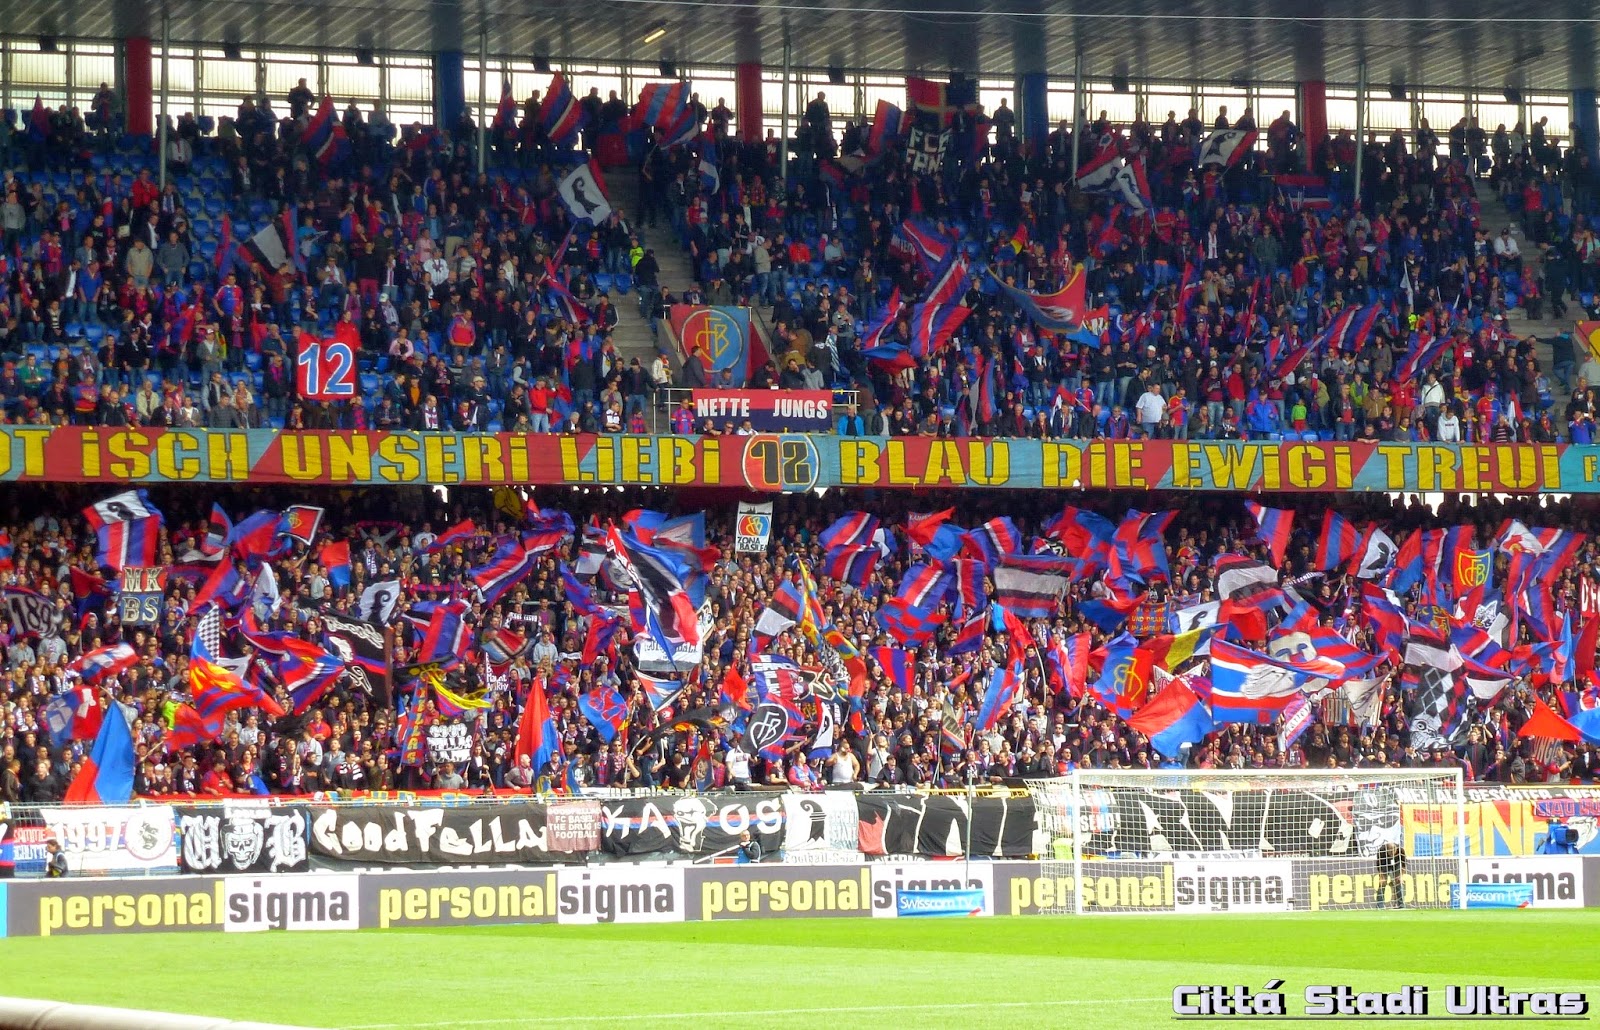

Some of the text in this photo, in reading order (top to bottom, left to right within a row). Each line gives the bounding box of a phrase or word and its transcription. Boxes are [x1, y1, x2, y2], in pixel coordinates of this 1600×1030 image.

[298, 343, 355, 396] 12
[697, 398, 828, 419] NETTE JUNGS
[749, 439, 814, 486] 12
[839, 439, 1010, 487] BLAU
[737, 536, 761, 544] ZONA
[122, 567, 163, 593] MK
[122, 597, 160, 622] BS
[549, 823, 567, 831] THE
[569, 823, 592, 831] DRUG
[555, 815, 595, 823] FC BASEL
[53, 821, 122, 852] 1997
[555, 830, 598, 839] FOOTBALL
[380, 873, 674, 928] personal sigma
[701, 868, 871, 921] personal
[900, 895, 955, 910] Swisscom
[1010, 865, 1173, 916] personal
[1177, 865, 1284, 911] sigma
[40, 881, 350, 936] personal sigma
